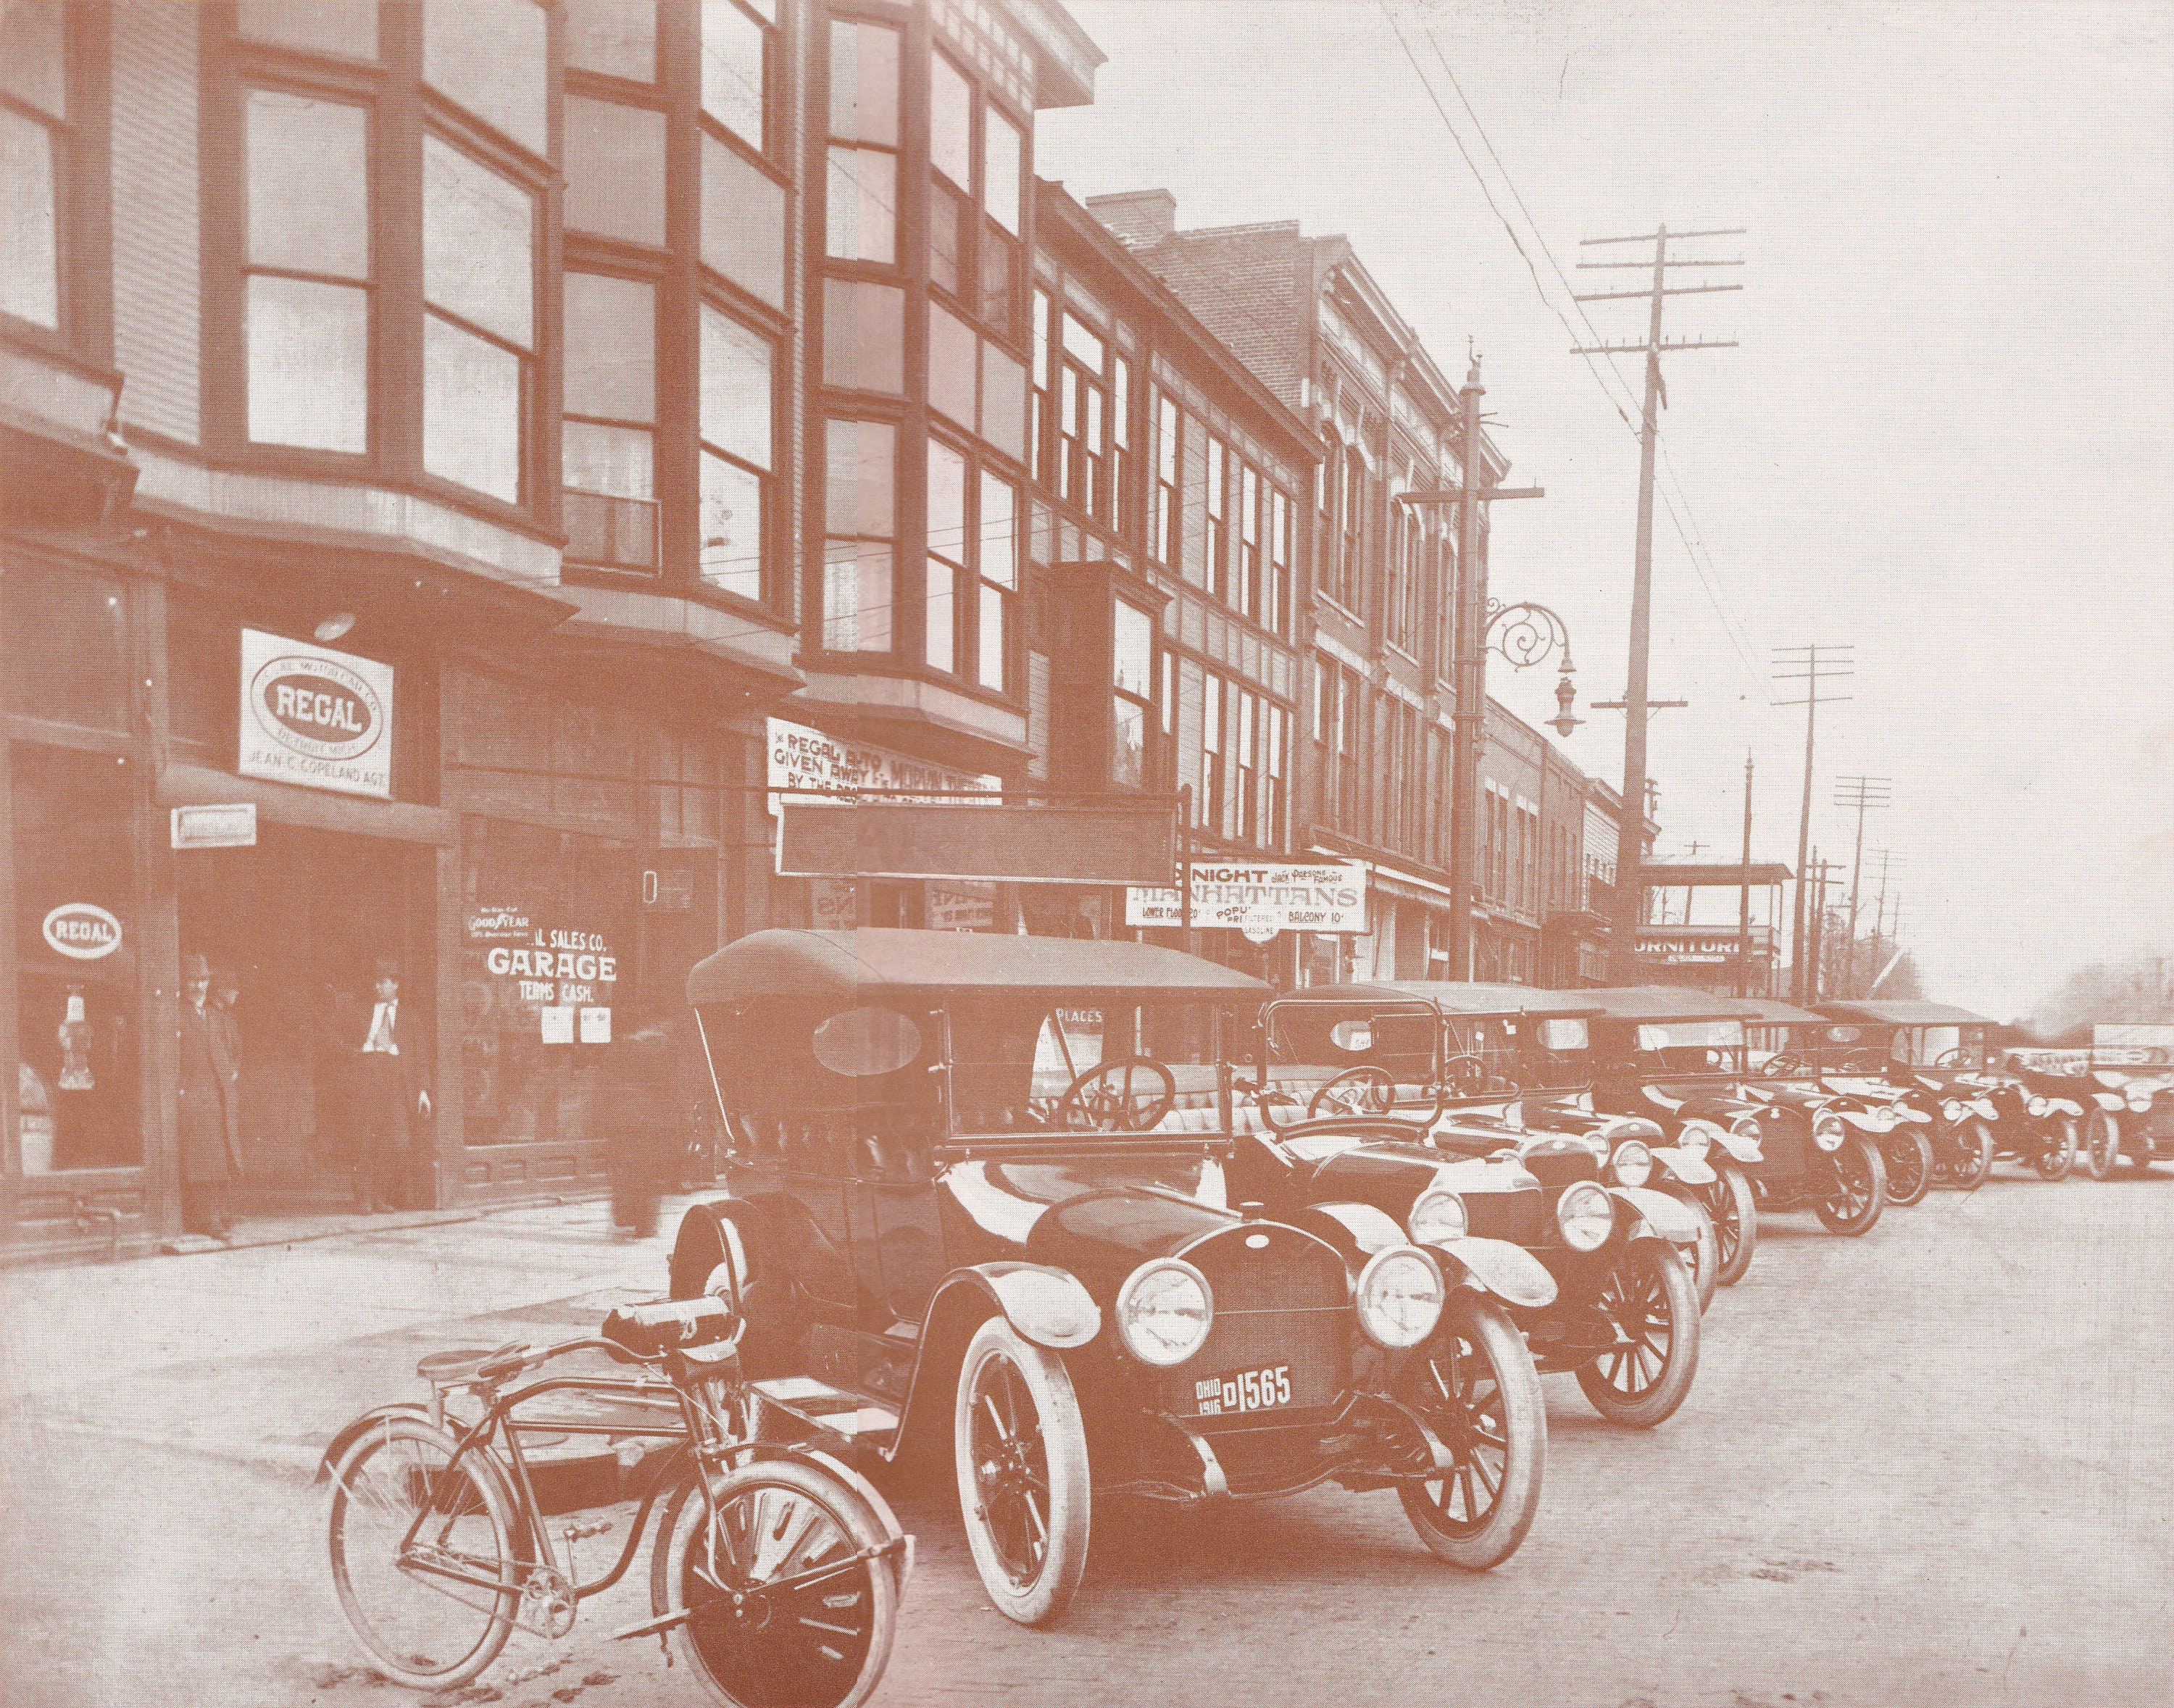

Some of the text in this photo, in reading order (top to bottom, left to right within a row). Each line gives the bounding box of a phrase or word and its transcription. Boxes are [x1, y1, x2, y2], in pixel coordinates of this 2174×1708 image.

[277, 684, 362, 733] REGAL
[787, 733, 841, 762] REGAL
[301, 759, 359, 782] COPELAND
[774, 748, 823, 775] GIVEN
[830, 763, 868, 784] AWAY
[788, 772, 804, 787] BY
[1133, 884, 1358, 907] MANHATTANS
[1167, 907, 1182, 919] FLOO
[1217, 906, 1249, 919] POPU
[1288, 911, 1326, 922] BALCONY
[56, 920, 112, 941] REGAL
[549, 929, 586, 951] SALES
[588, 933, 607, 951] CO.
[487, 947, 617, 981] GARAGE
[519, 980, 554, 1001] TERMS
[1196, 1378, 1221, 1400] OHIO
[1199, 1399, 1221, 1414] 1916
